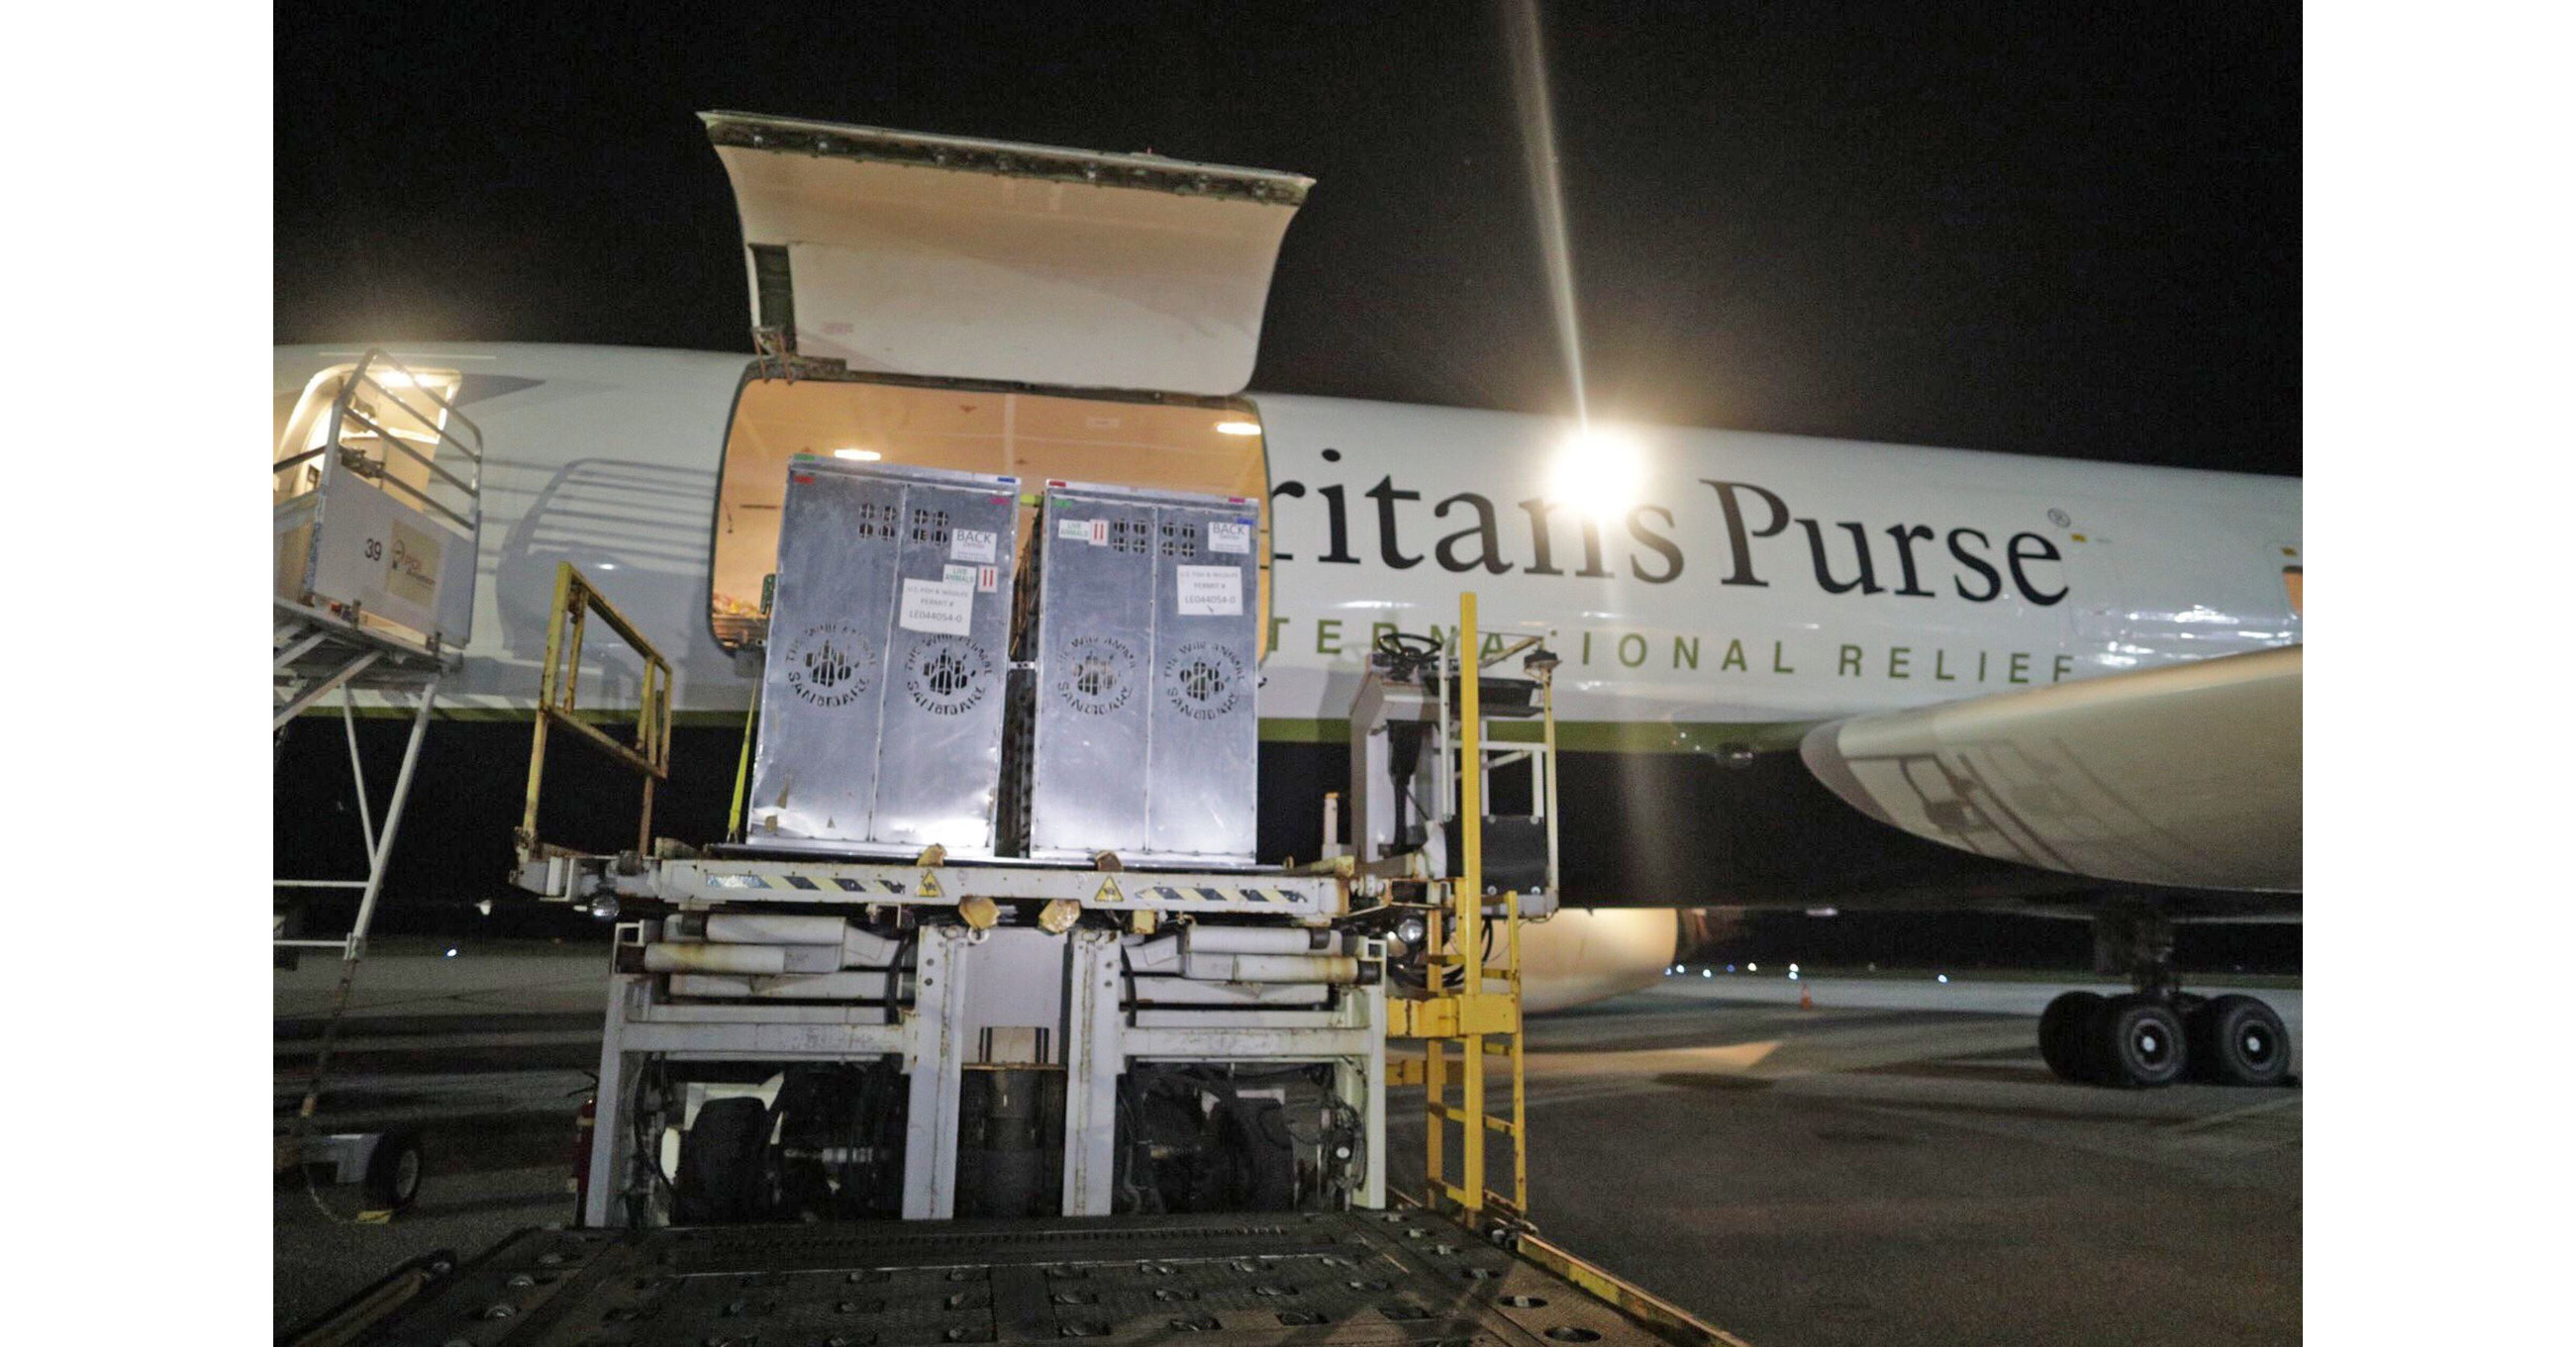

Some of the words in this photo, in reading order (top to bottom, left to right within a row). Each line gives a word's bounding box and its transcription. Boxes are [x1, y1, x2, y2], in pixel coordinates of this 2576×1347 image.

[956, 529, 992, 544] BACK
[1212, 523, 1245, 535] BACK
[364, 538, 382, 561] 39
[1838, 644, 2075, 684] RELIEF
